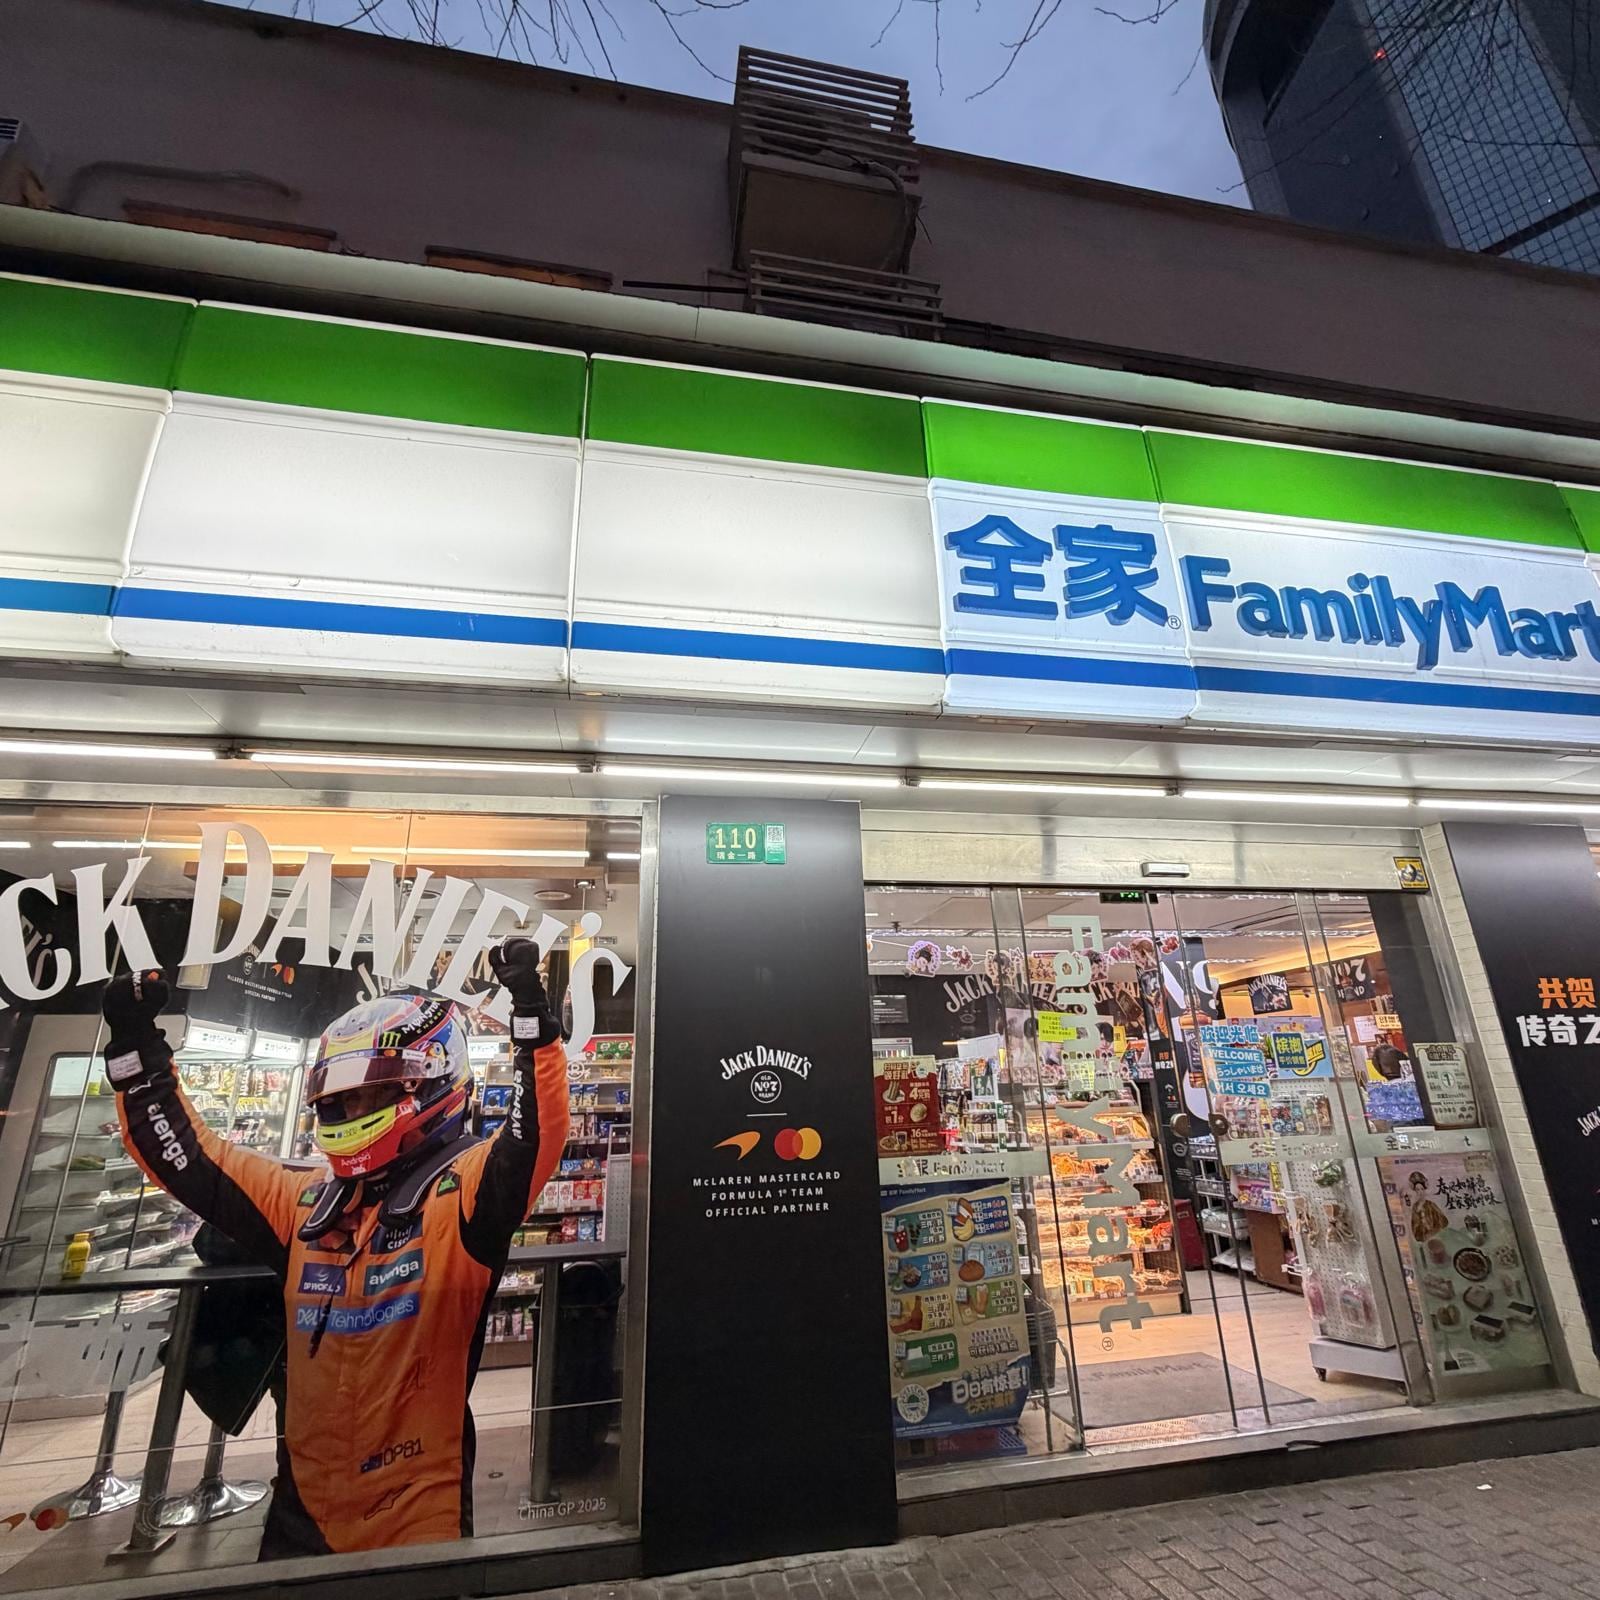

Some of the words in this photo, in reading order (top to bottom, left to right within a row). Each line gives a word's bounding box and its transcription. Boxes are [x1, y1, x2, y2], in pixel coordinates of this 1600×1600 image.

[943, 513, 1170, 628] 全家
[1179, 554, 1600, 671] FamilyMart
[715, 828, 757, 849] 110
[0, 856, 162, 1009] CK
[943, 973, 994, 1013] JACK
[1538, 977, 1597, 1009] 共贺
[1200, 1025, 1259, 1043] 欢迎光临
[720, 1050, 757, 1081] JACK
[756, 1045, 812, 1081] DANIEL'S
[1208, 1048, 1260, 1061] WELCOME
[1216, 1063, 1264, 1077] らっしゃいませ
[1047, 914, 1154, 1333] FamilyMart
[693, 1175, 752, 1187] McLAREN
[759, 1171, 841, 1184] MASTERCARD
[711, 1191, 773, 1202] FORMULA
[791, 1187, 824, 1197] TEAM
[705, 1206, 767, 1218] OFFICIAL
[773, 1202, 830, 1214] PARTNER
[387, 1236, 410, 1249] cisc
[330, 1298, 414, 1329] Tehnologies
[519, 1500, 555, 1521] China
[557, 1501, 576, 1517] GP
